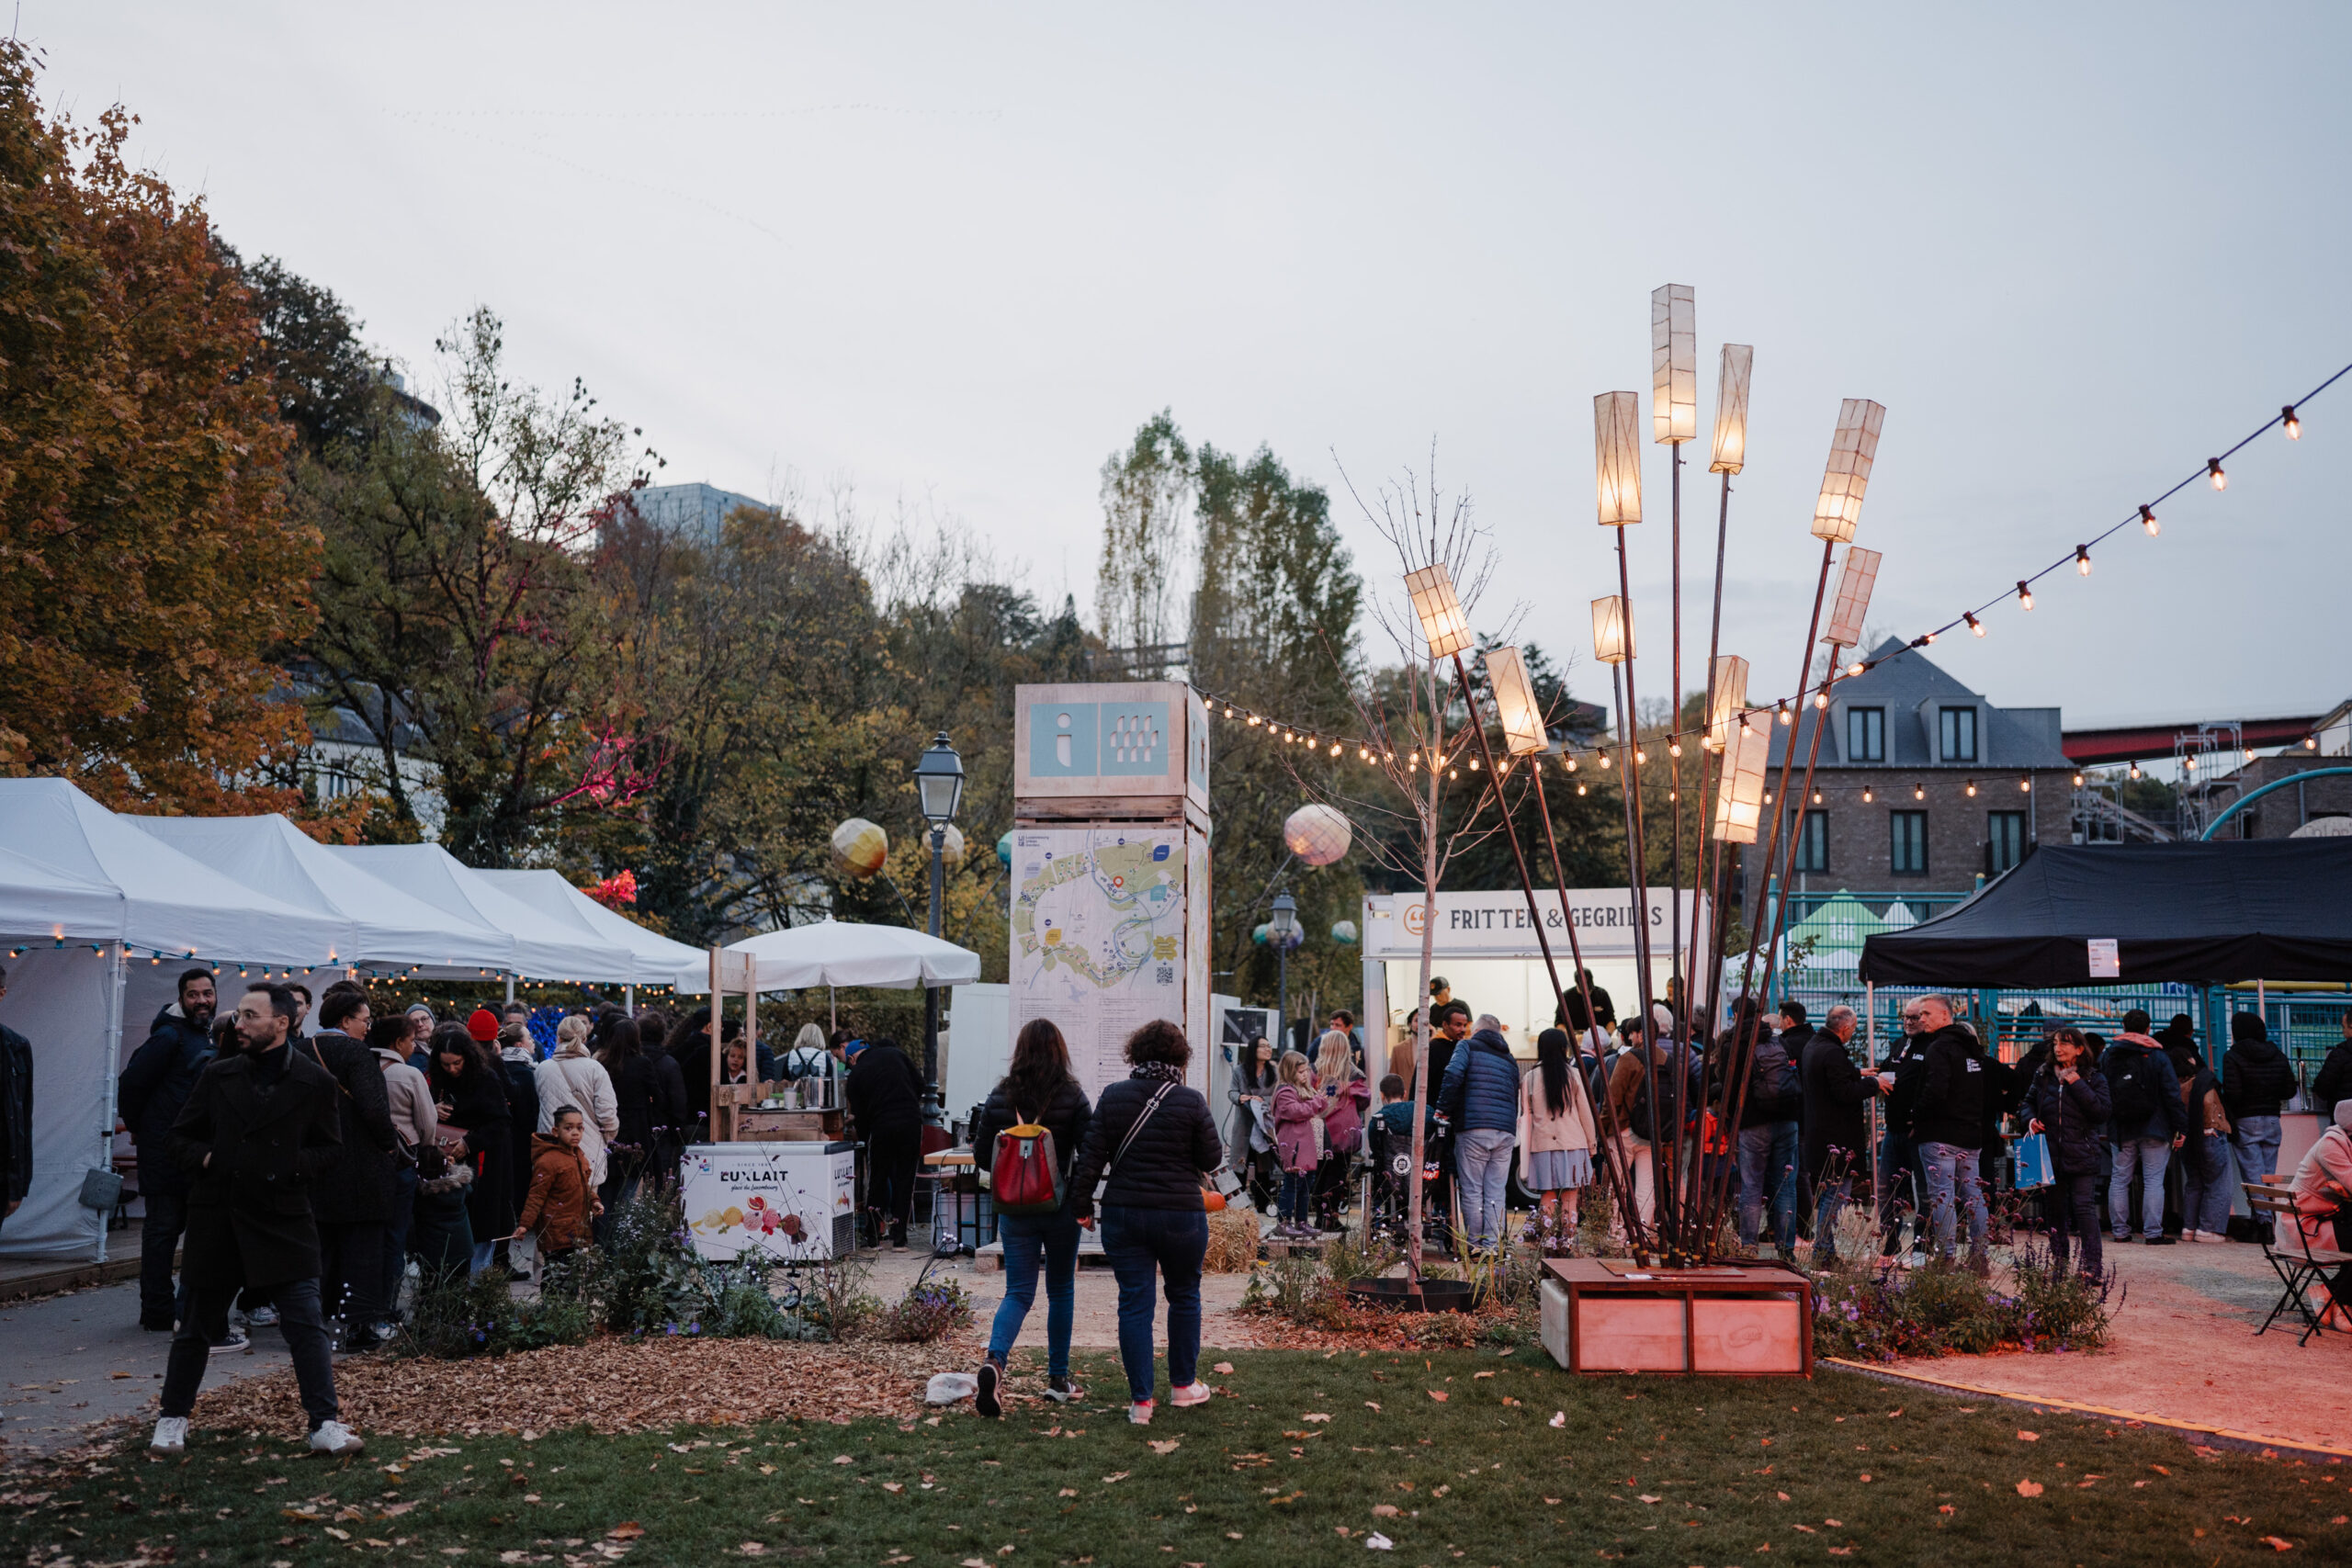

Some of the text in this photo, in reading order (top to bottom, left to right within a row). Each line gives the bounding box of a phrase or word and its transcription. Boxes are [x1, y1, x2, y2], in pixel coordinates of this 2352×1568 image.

[1547, 909, 1563, 928] &
[1572, 907, 1662, 927] GEGRILS
[720, 1171, 788, 1181] LUXLAIT
[751, 1183, 778, 1192] Luxembourg
